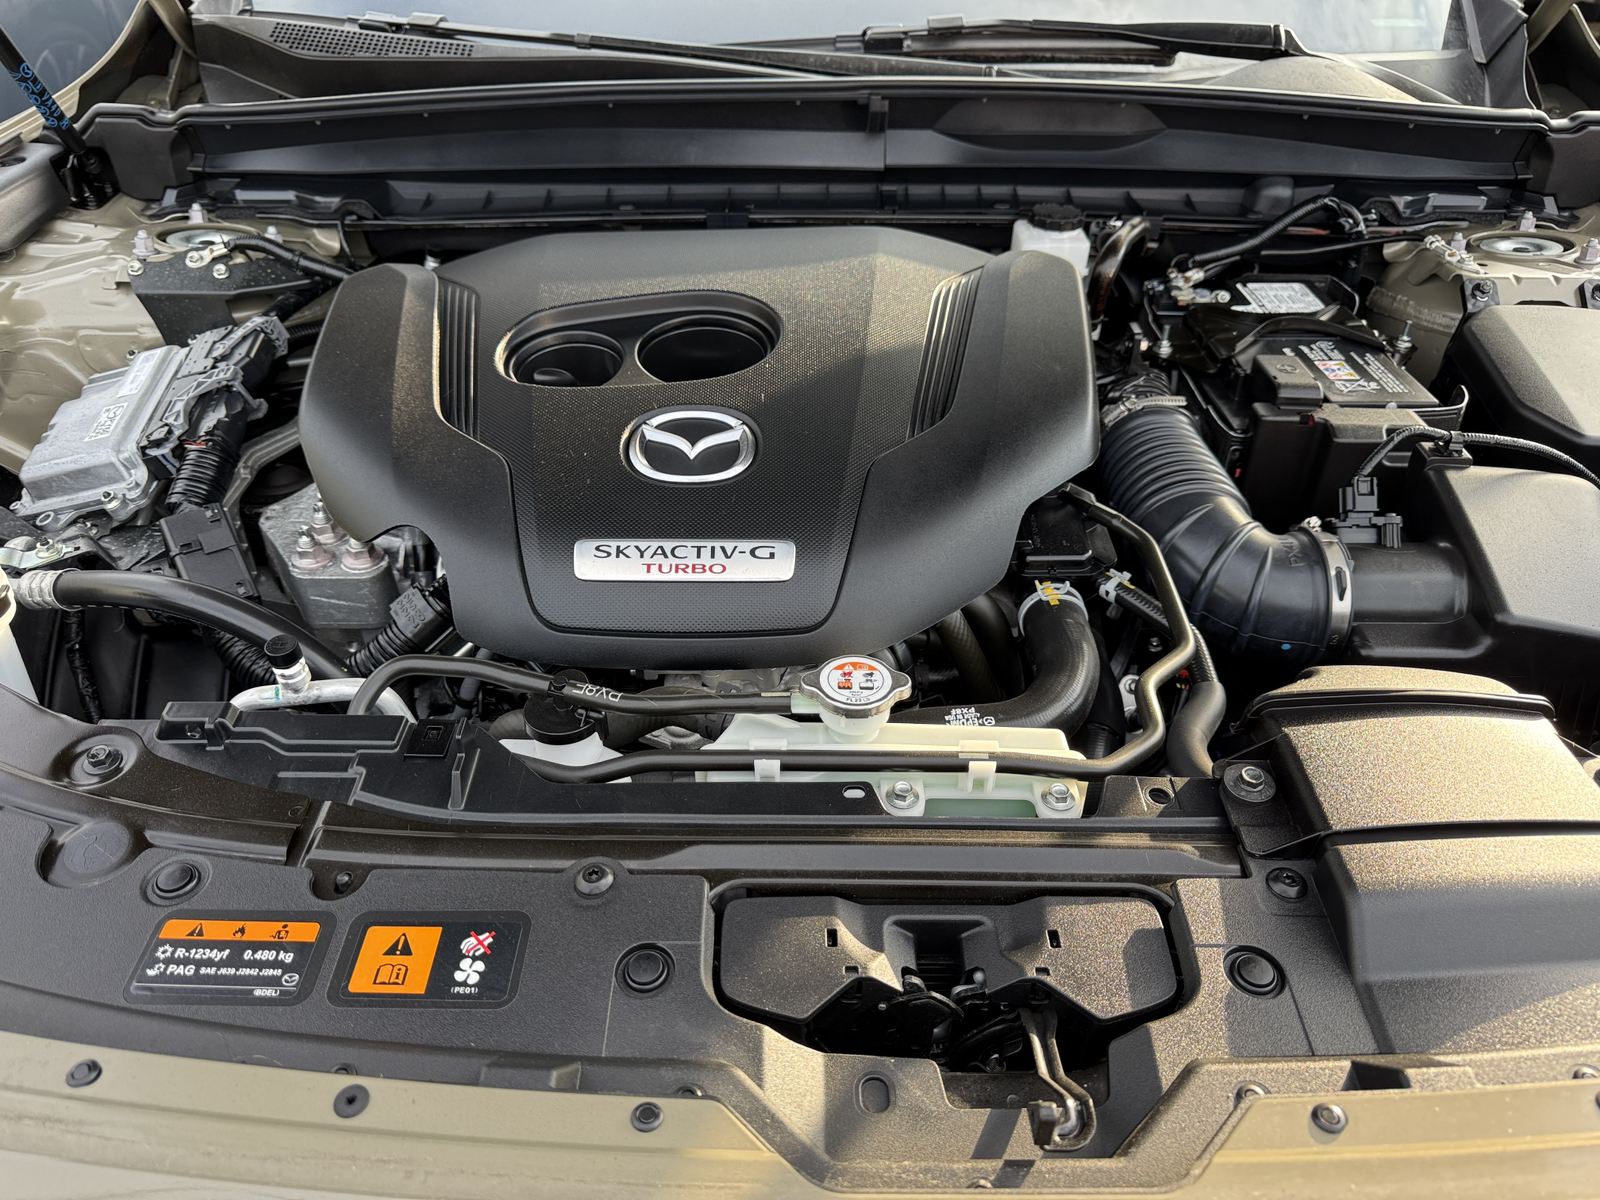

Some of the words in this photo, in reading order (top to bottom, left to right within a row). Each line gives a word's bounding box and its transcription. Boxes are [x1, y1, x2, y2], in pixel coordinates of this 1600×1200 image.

[593, 544, 776, 560] SKYACTIV-G
[641, 563, 727, 575] TURBO
[174, 948, 231, 961] R-1234yf
[243, 949, 277, 961] 0.480
[278, 951, 294, 963] kg
[166, 964, 196, 976] PAG
[200, 967, 217, 975] SAE
[217, 967, 236, 975] J639
[236, 968, 259, 976] J2842
[259, 969, 282, 977] J2845
[253, 988, 280, 997] (BDEL)
[450, 986, 479, 994] (PE01)
